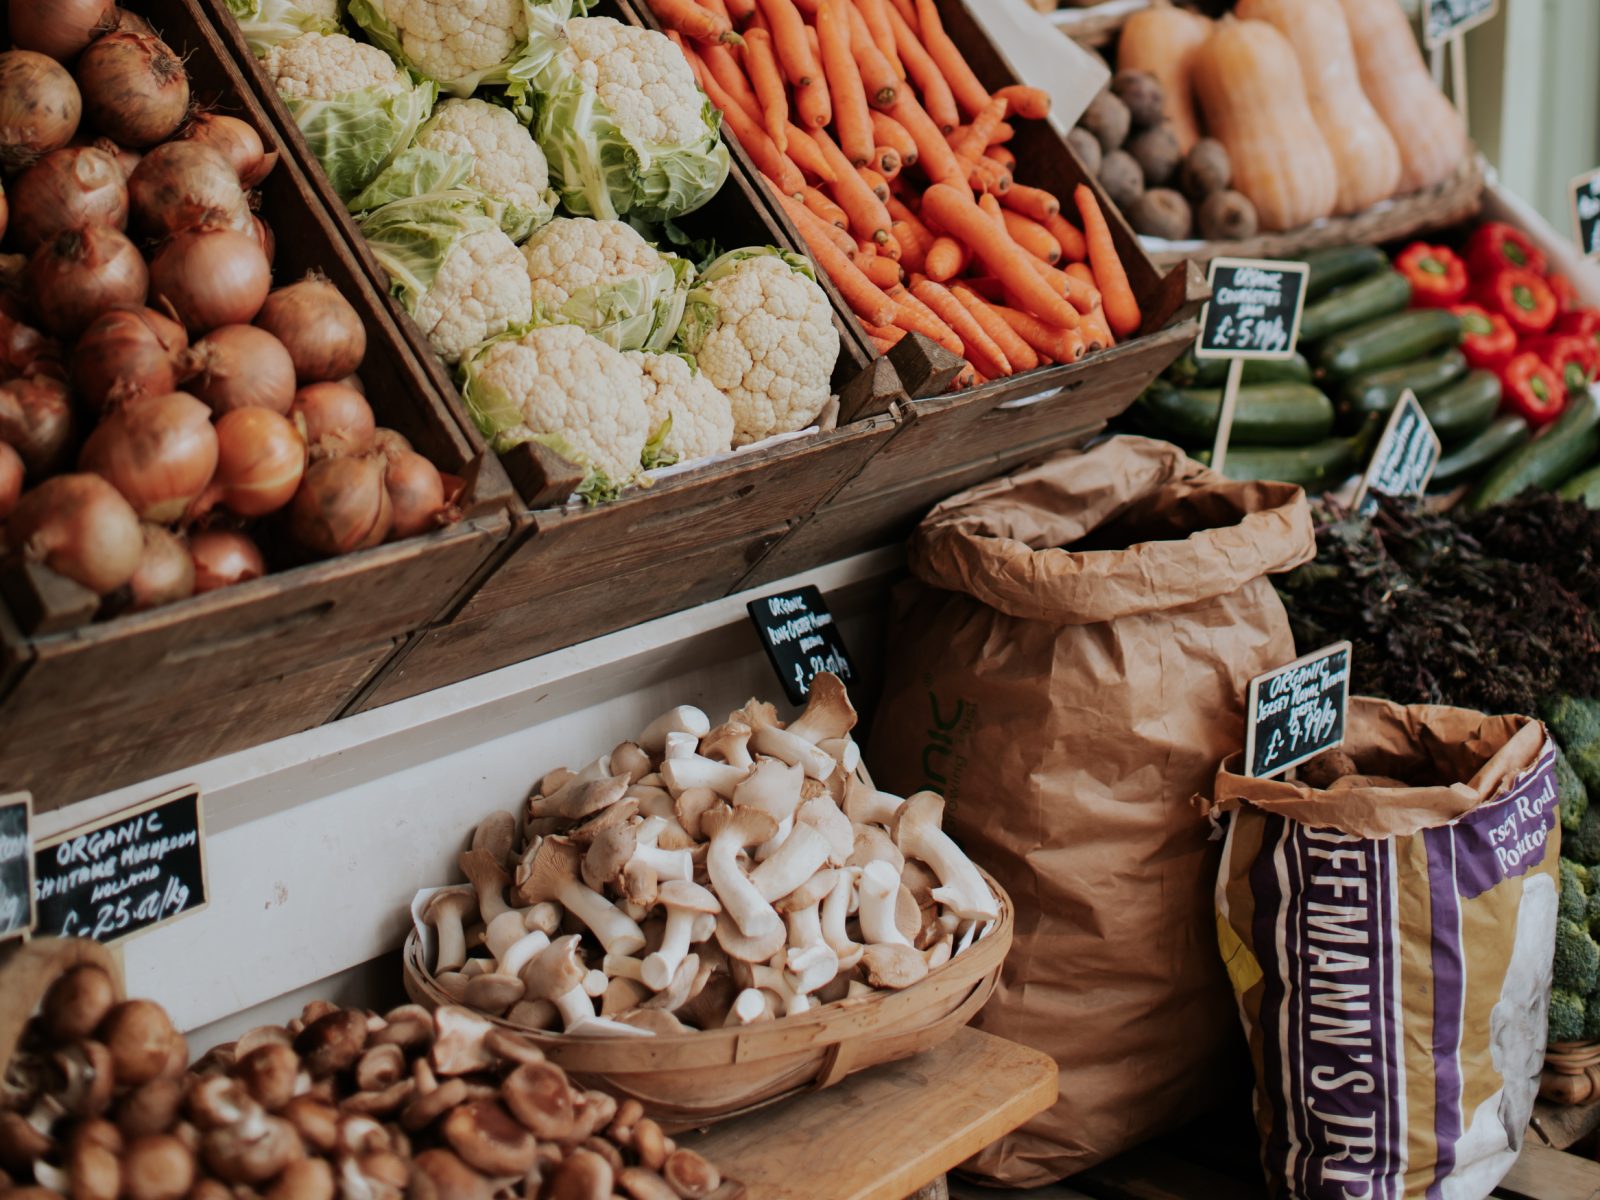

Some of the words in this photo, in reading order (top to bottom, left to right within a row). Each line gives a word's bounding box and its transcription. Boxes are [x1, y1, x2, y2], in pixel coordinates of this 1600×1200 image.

[1269, 656, 1330, 699] ORGANIC
[916, 689, 965, 796] nic
[56, 812, 163, 865] ORGANIC
[120, 830, 196, 867] MUSHROOM
[91, 864, 160, 904] HOLLAND
